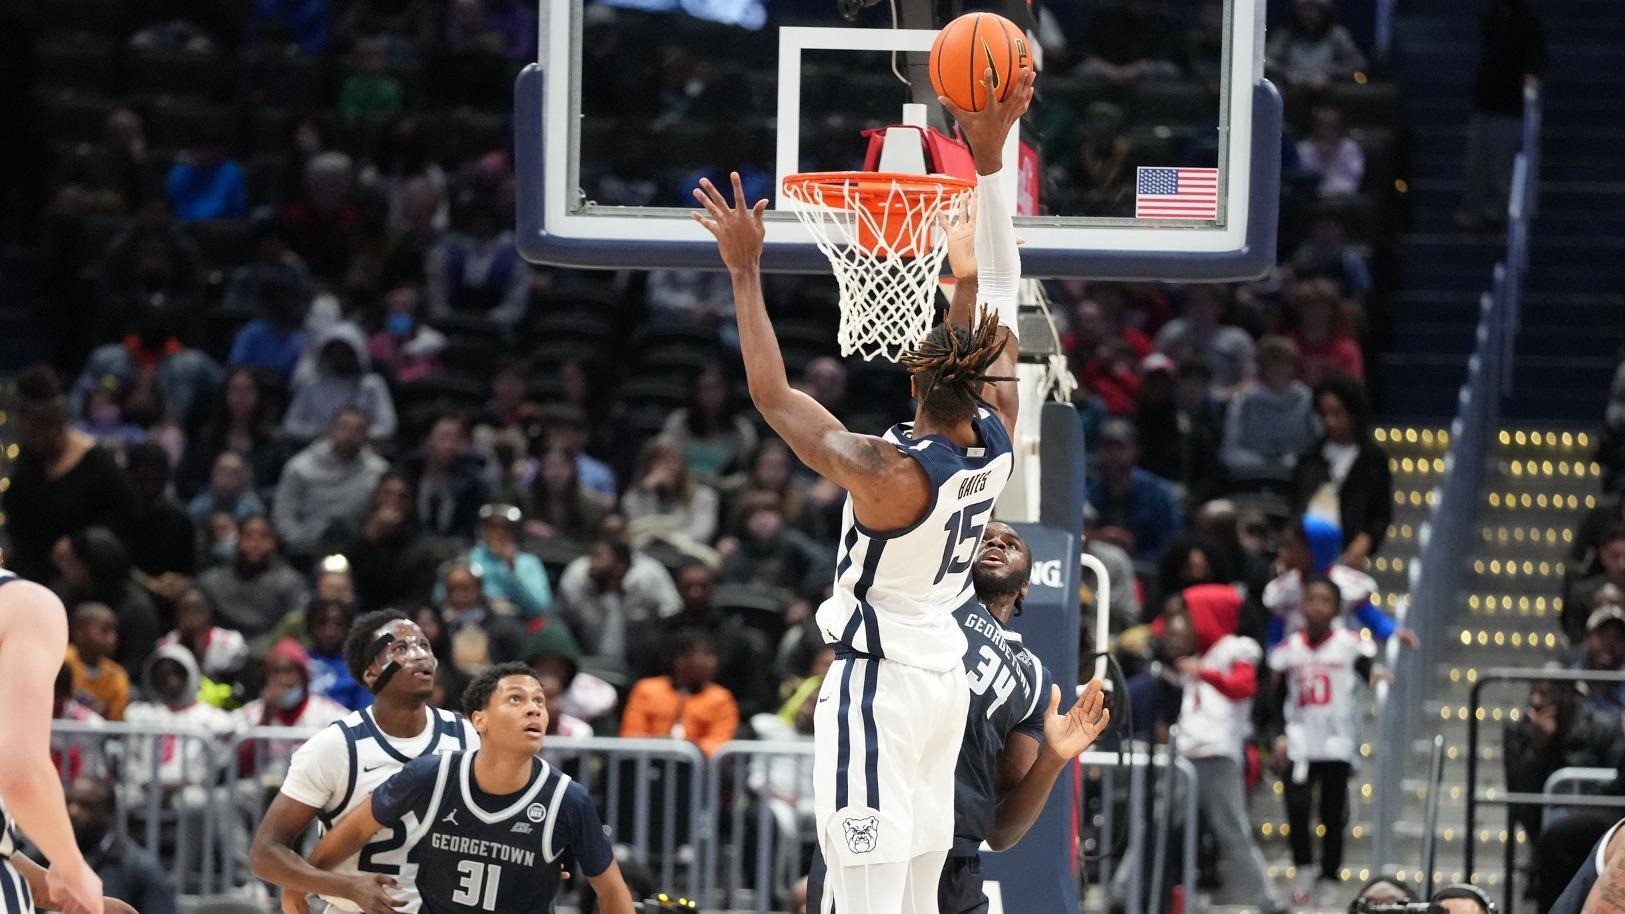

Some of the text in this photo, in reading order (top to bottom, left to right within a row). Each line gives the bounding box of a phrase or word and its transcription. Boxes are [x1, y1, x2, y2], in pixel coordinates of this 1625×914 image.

[957, 471, 992, 500] BATES
[933, 498, 994, 585] 15
[1029, 559, 1065, 588] NG
[964, 613, 1031, 699] GEORGETOWN
[966, 645, 1017, 720] 34
[432, 833, 535, 867] GEORGETOWN
[452, 860, 502, 911] 31
